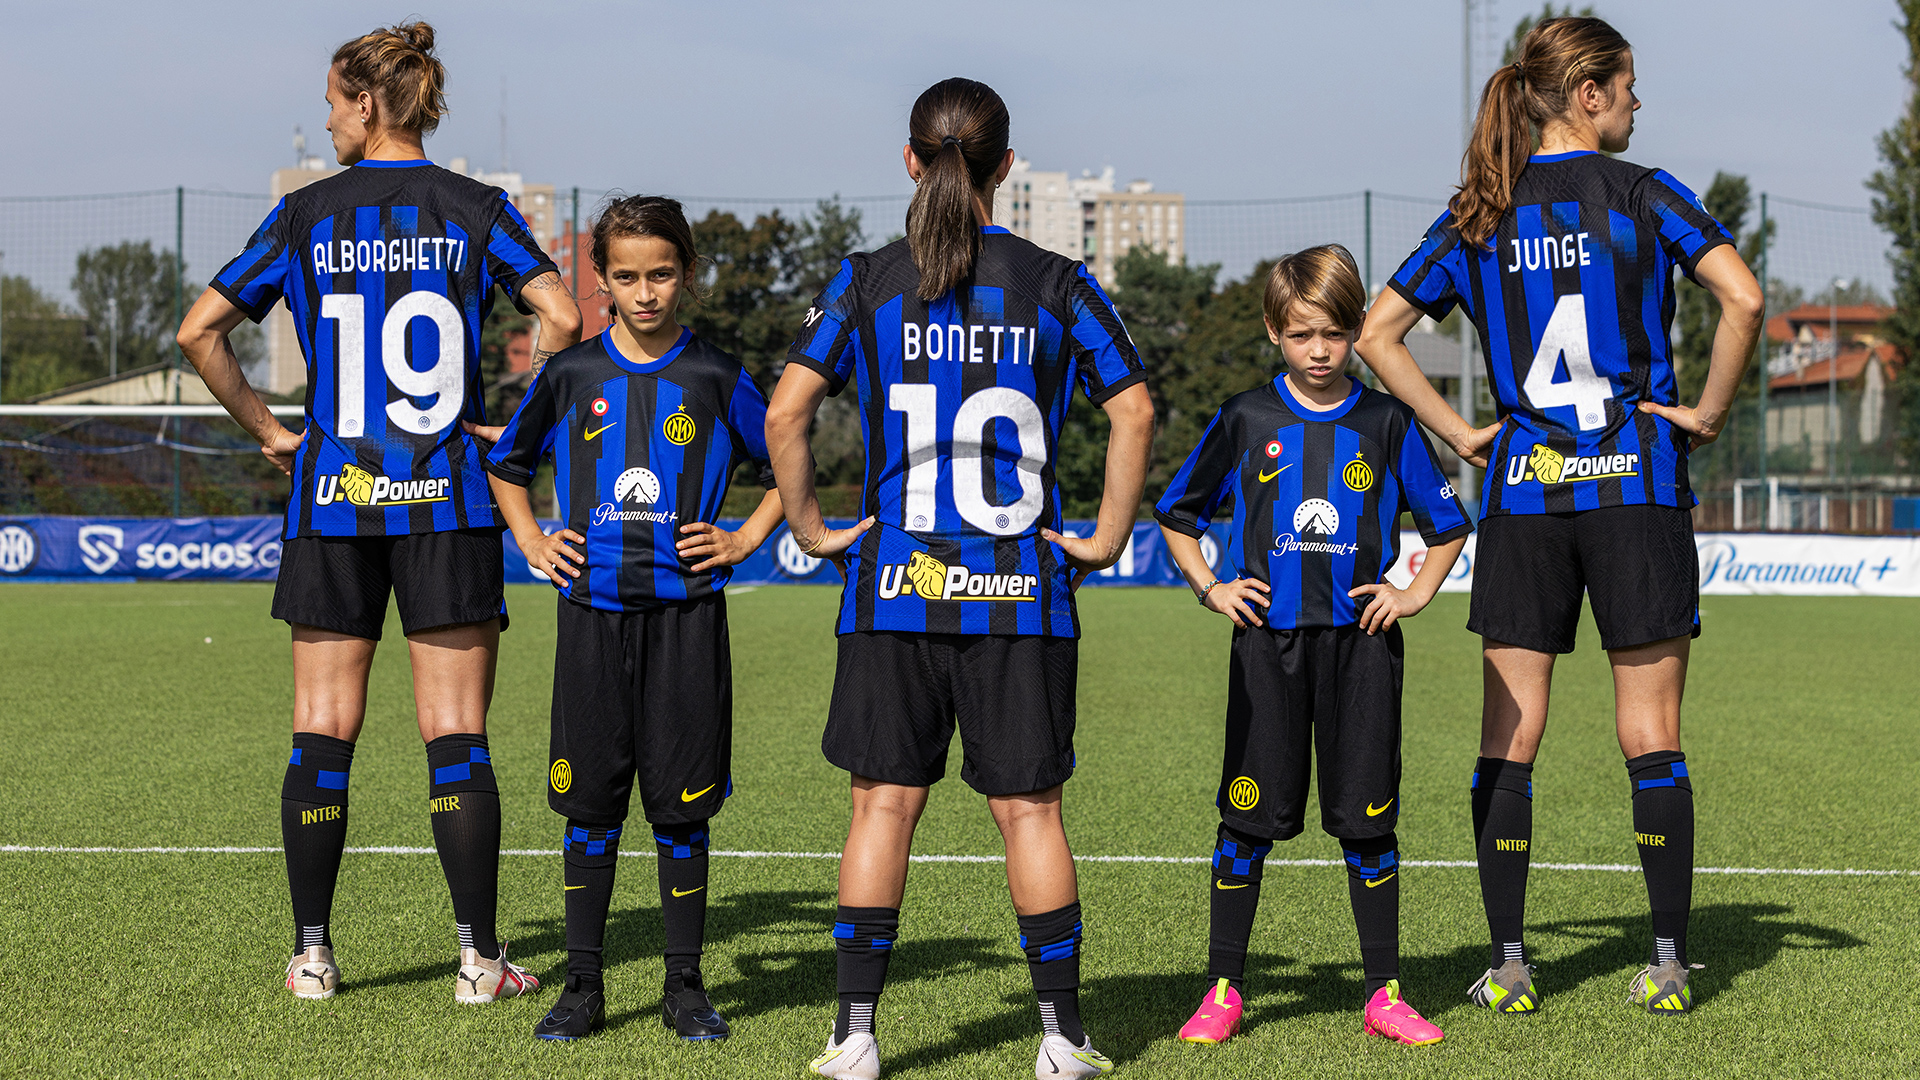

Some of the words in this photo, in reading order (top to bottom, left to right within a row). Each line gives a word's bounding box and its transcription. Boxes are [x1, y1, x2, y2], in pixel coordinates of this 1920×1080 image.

[313, 237, 465, 276] ALBORGHETTI
[1508, 232, 1591, 273] JUNGE
[321, 290, 465, 438] 19
[903, 322, 1036, 365] BONETTI
[1522, 293, 1614, 432] 4
[889, 383, 1047, 536] 10
[302, 805, 341, 825] INTER
[1496, 838, 1528, 852] INTER
